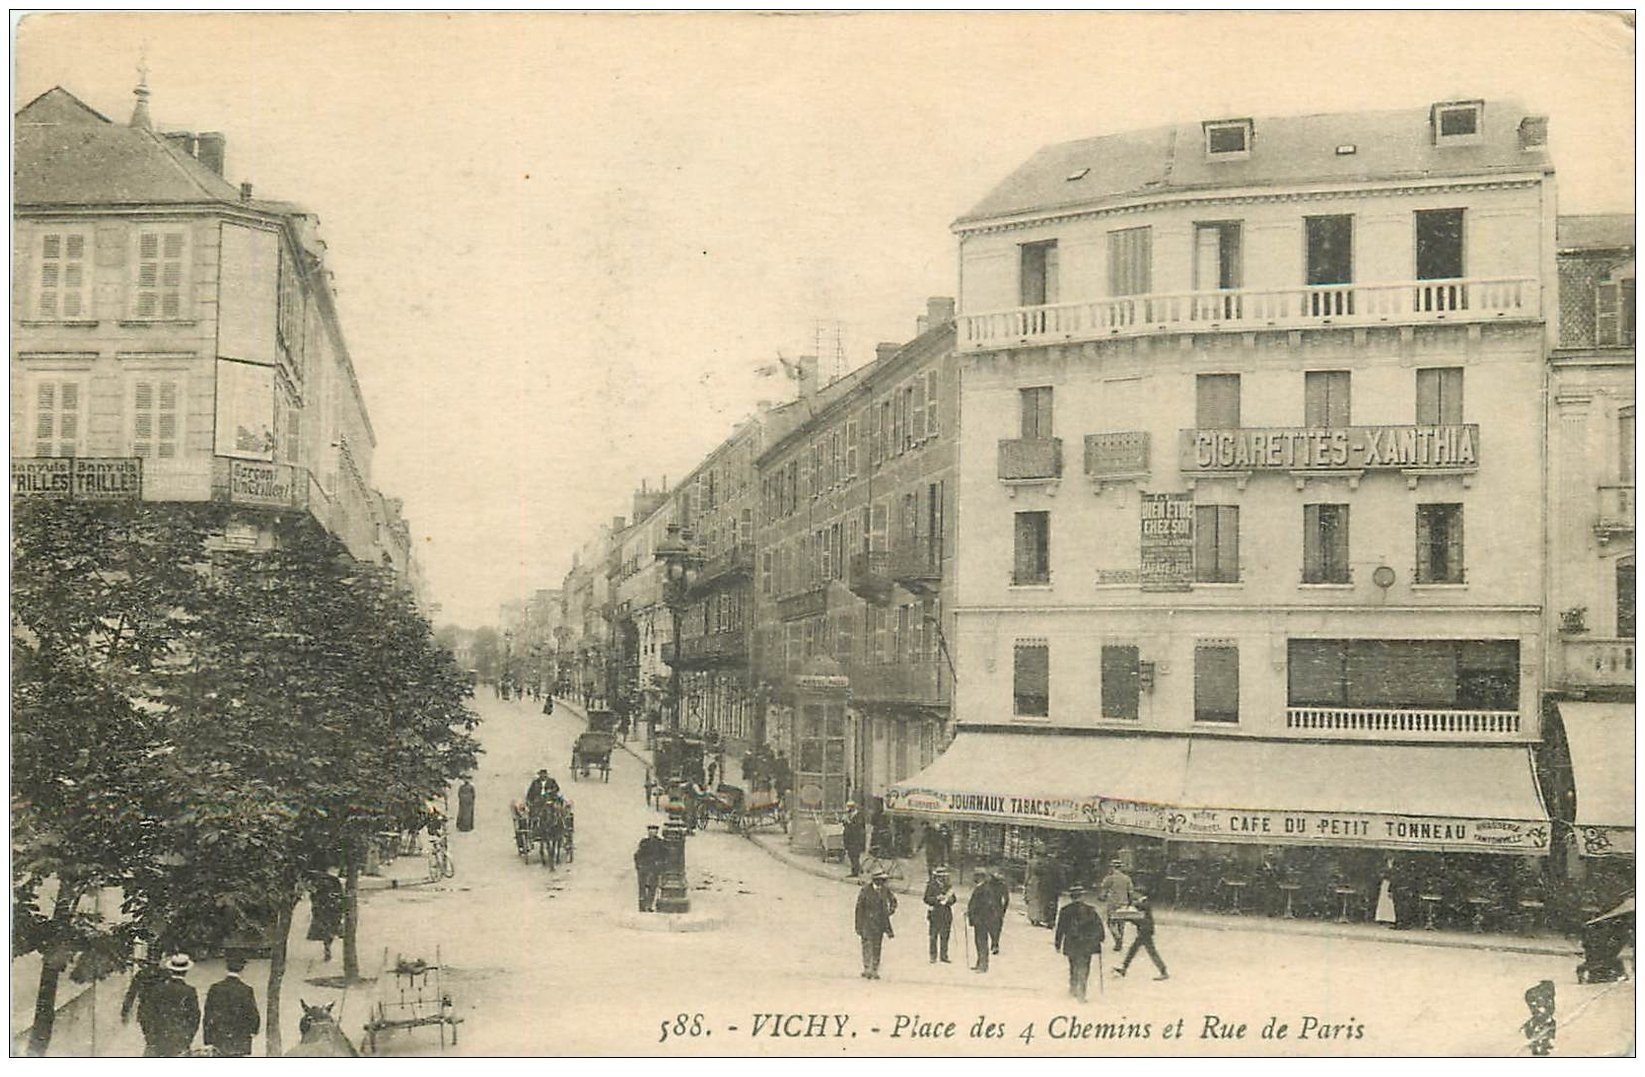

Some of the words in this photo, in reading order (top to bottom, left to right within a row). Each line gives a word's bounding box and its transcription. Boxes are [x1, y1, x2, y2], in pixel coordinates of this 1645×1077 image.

[78, 461, 136, 474] Banyuls
[76, 474, 139, 492] TRILLES
[1144, 519, 1169, 534] CHEZ
[1171, 519, 1190, 534] SOI
[949, 794, 1005, 813] JOURNAUX
[1010, 798, 1050, 816] TABACS
[1230, 816, 1271, 832] CAFE
[1286, 817, 1306, 833] DU
[1321, 819, 1369, 836] PETIT
[1386, 821, 1466, 840] TONNEAU
